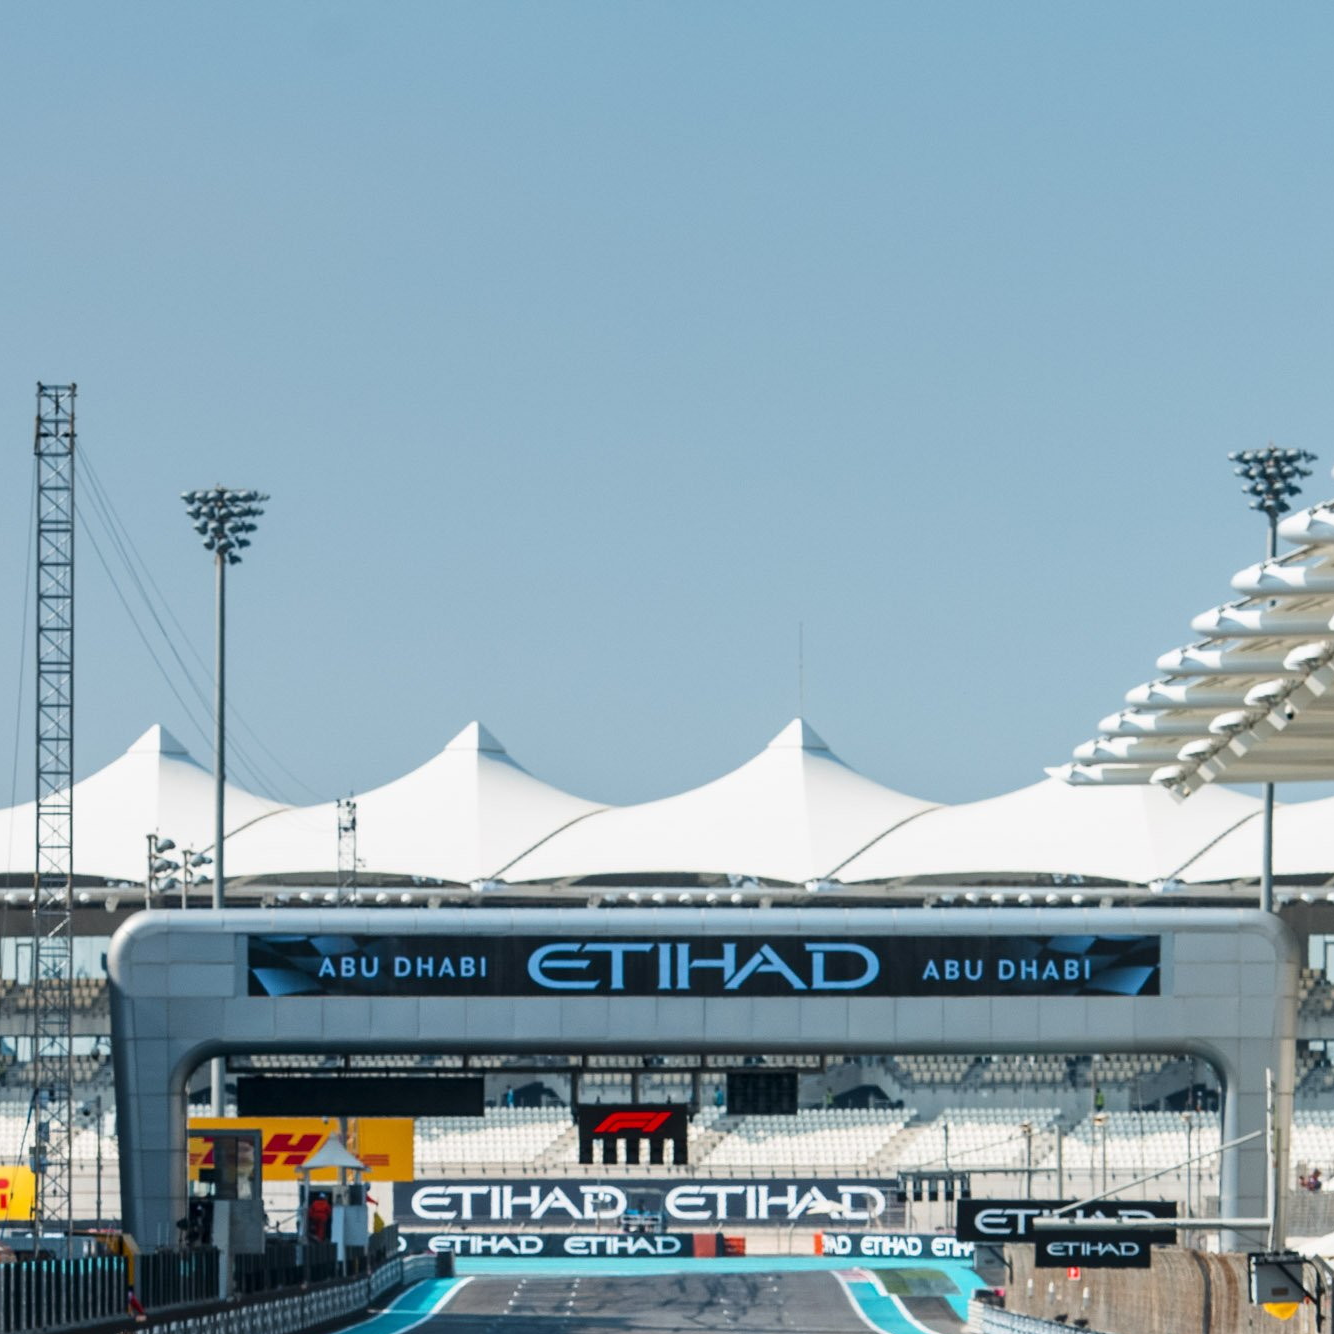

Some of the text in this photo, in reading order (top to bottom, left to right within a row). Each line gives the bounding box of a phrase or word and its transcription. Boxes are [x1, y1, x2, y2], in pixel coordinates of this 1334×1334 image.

[319, 943, 1091, 990] ABU DHABI ETIHAD ABU DHABI
[411, 1185, 886, 1221] ETIHAD ETIHAD
[428, 1235, 681, 1255] ETIHAD ETIHAD
[860, 1235, 922, 1256] ETIHAD
[1046, 1242, 1139, 1256] ETIHAD
